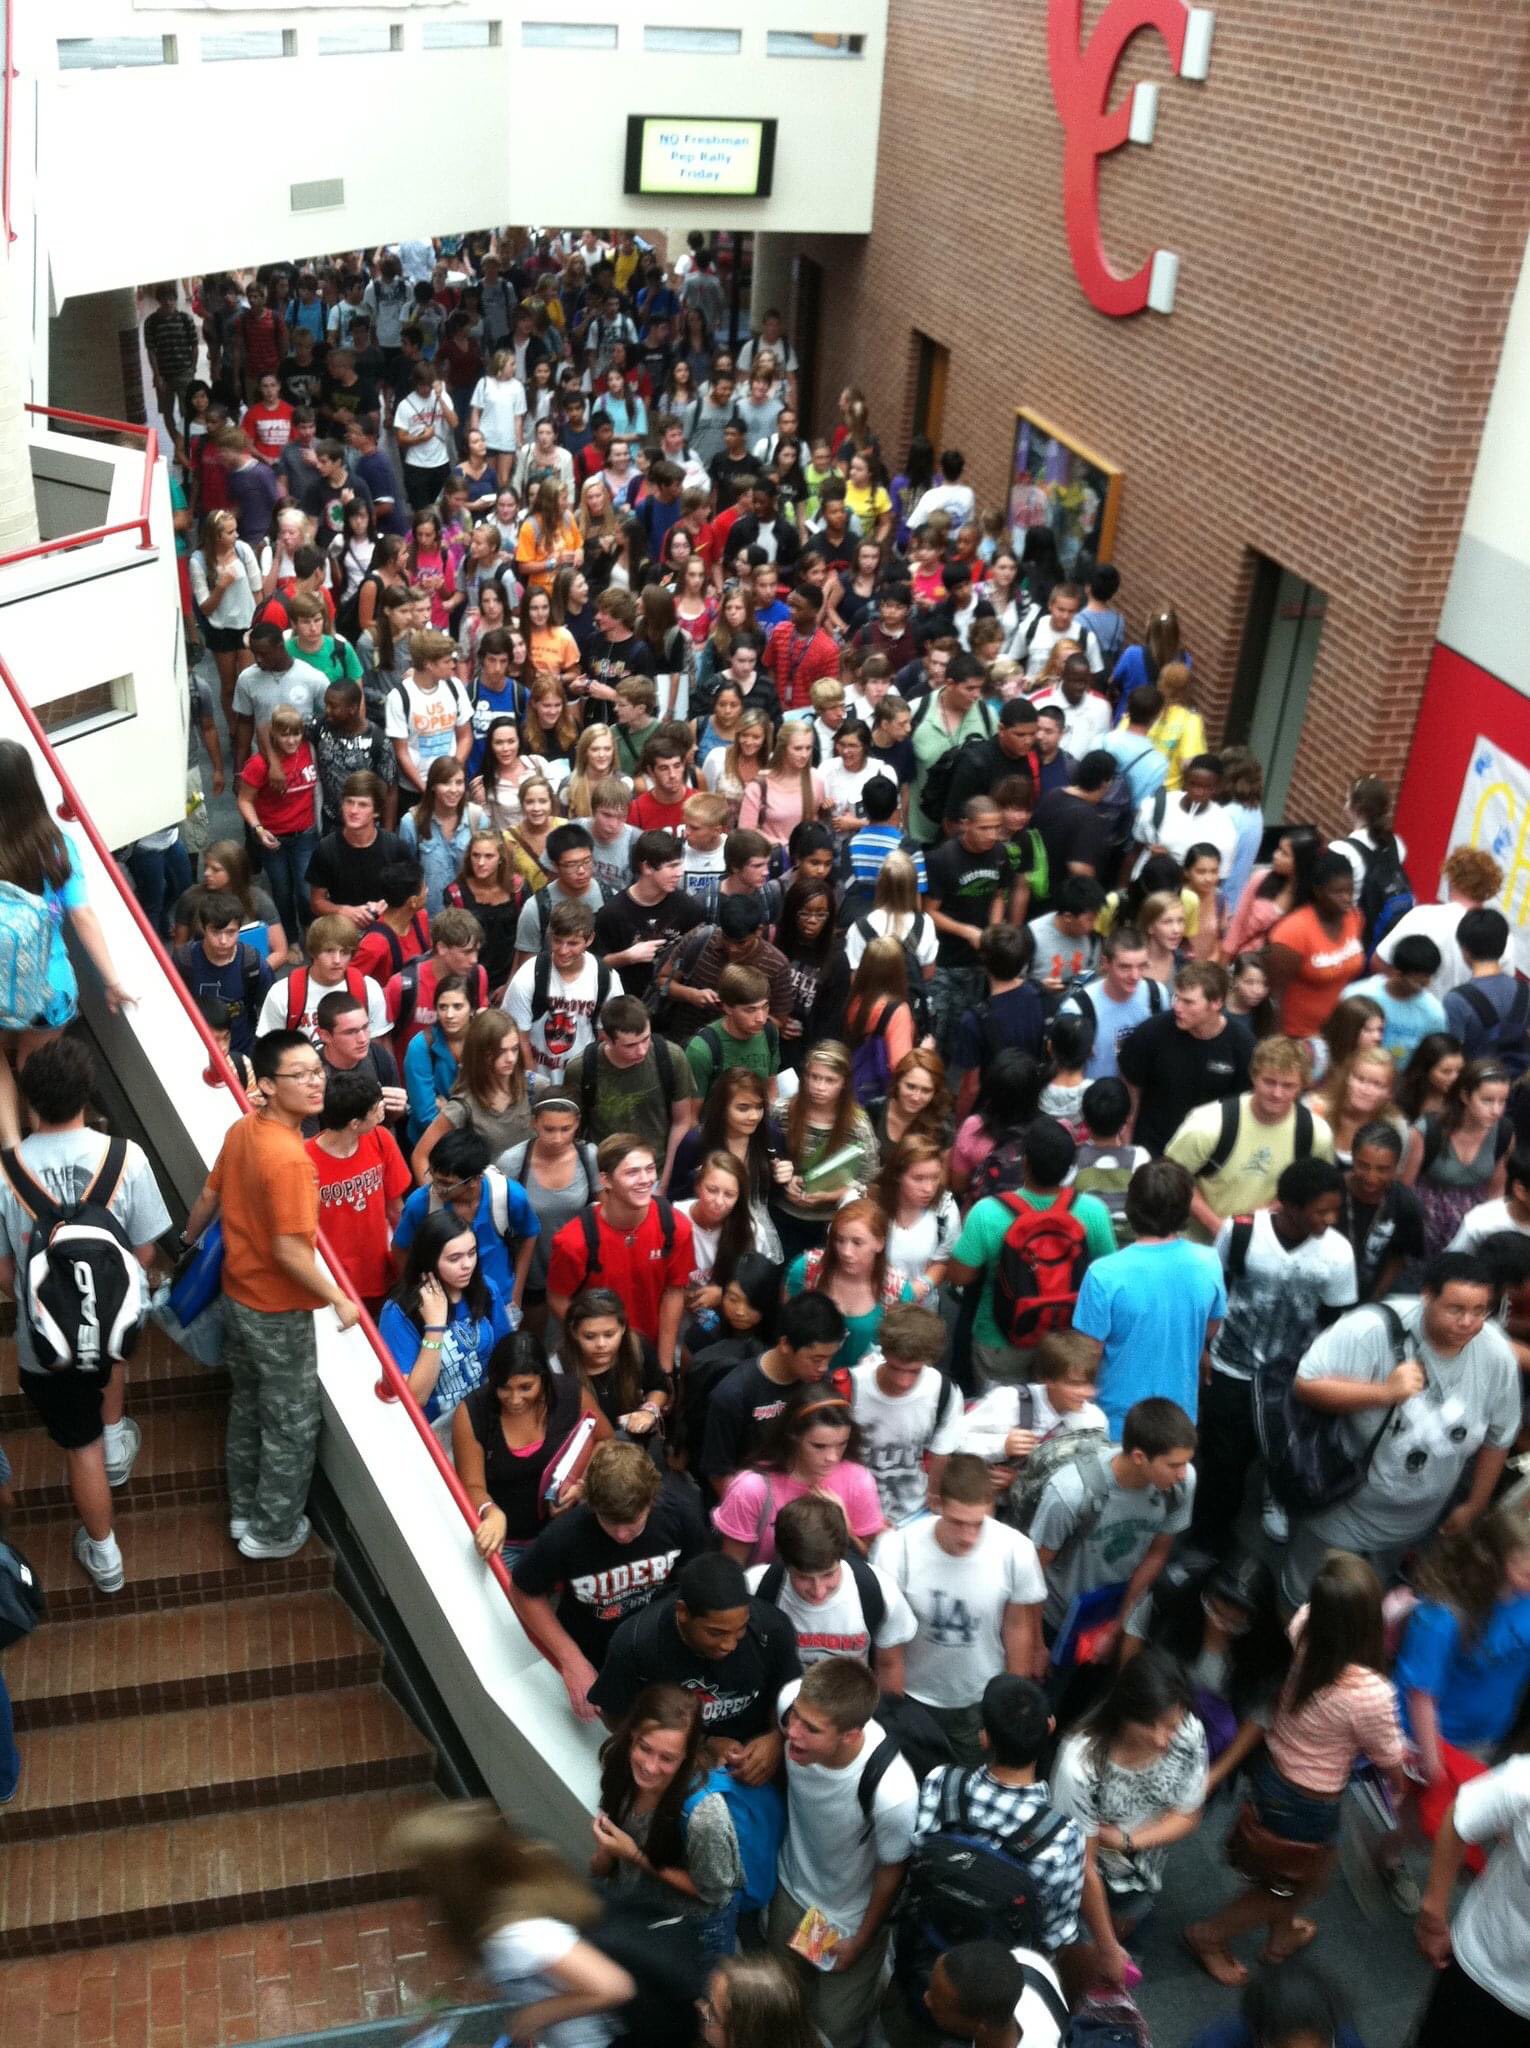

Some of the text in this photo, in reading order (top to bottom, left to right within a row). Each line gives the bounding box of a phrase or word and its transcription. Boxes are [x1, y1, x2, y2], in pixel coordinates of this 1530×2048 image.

[660, 133, 679, 146] NO
[671, 151, 731, 165] Pep Rally
[680, 168, 719, 181] Friday
[426, 702, 444, 716] US
[73, 1260, 99, 1371] HEAD
